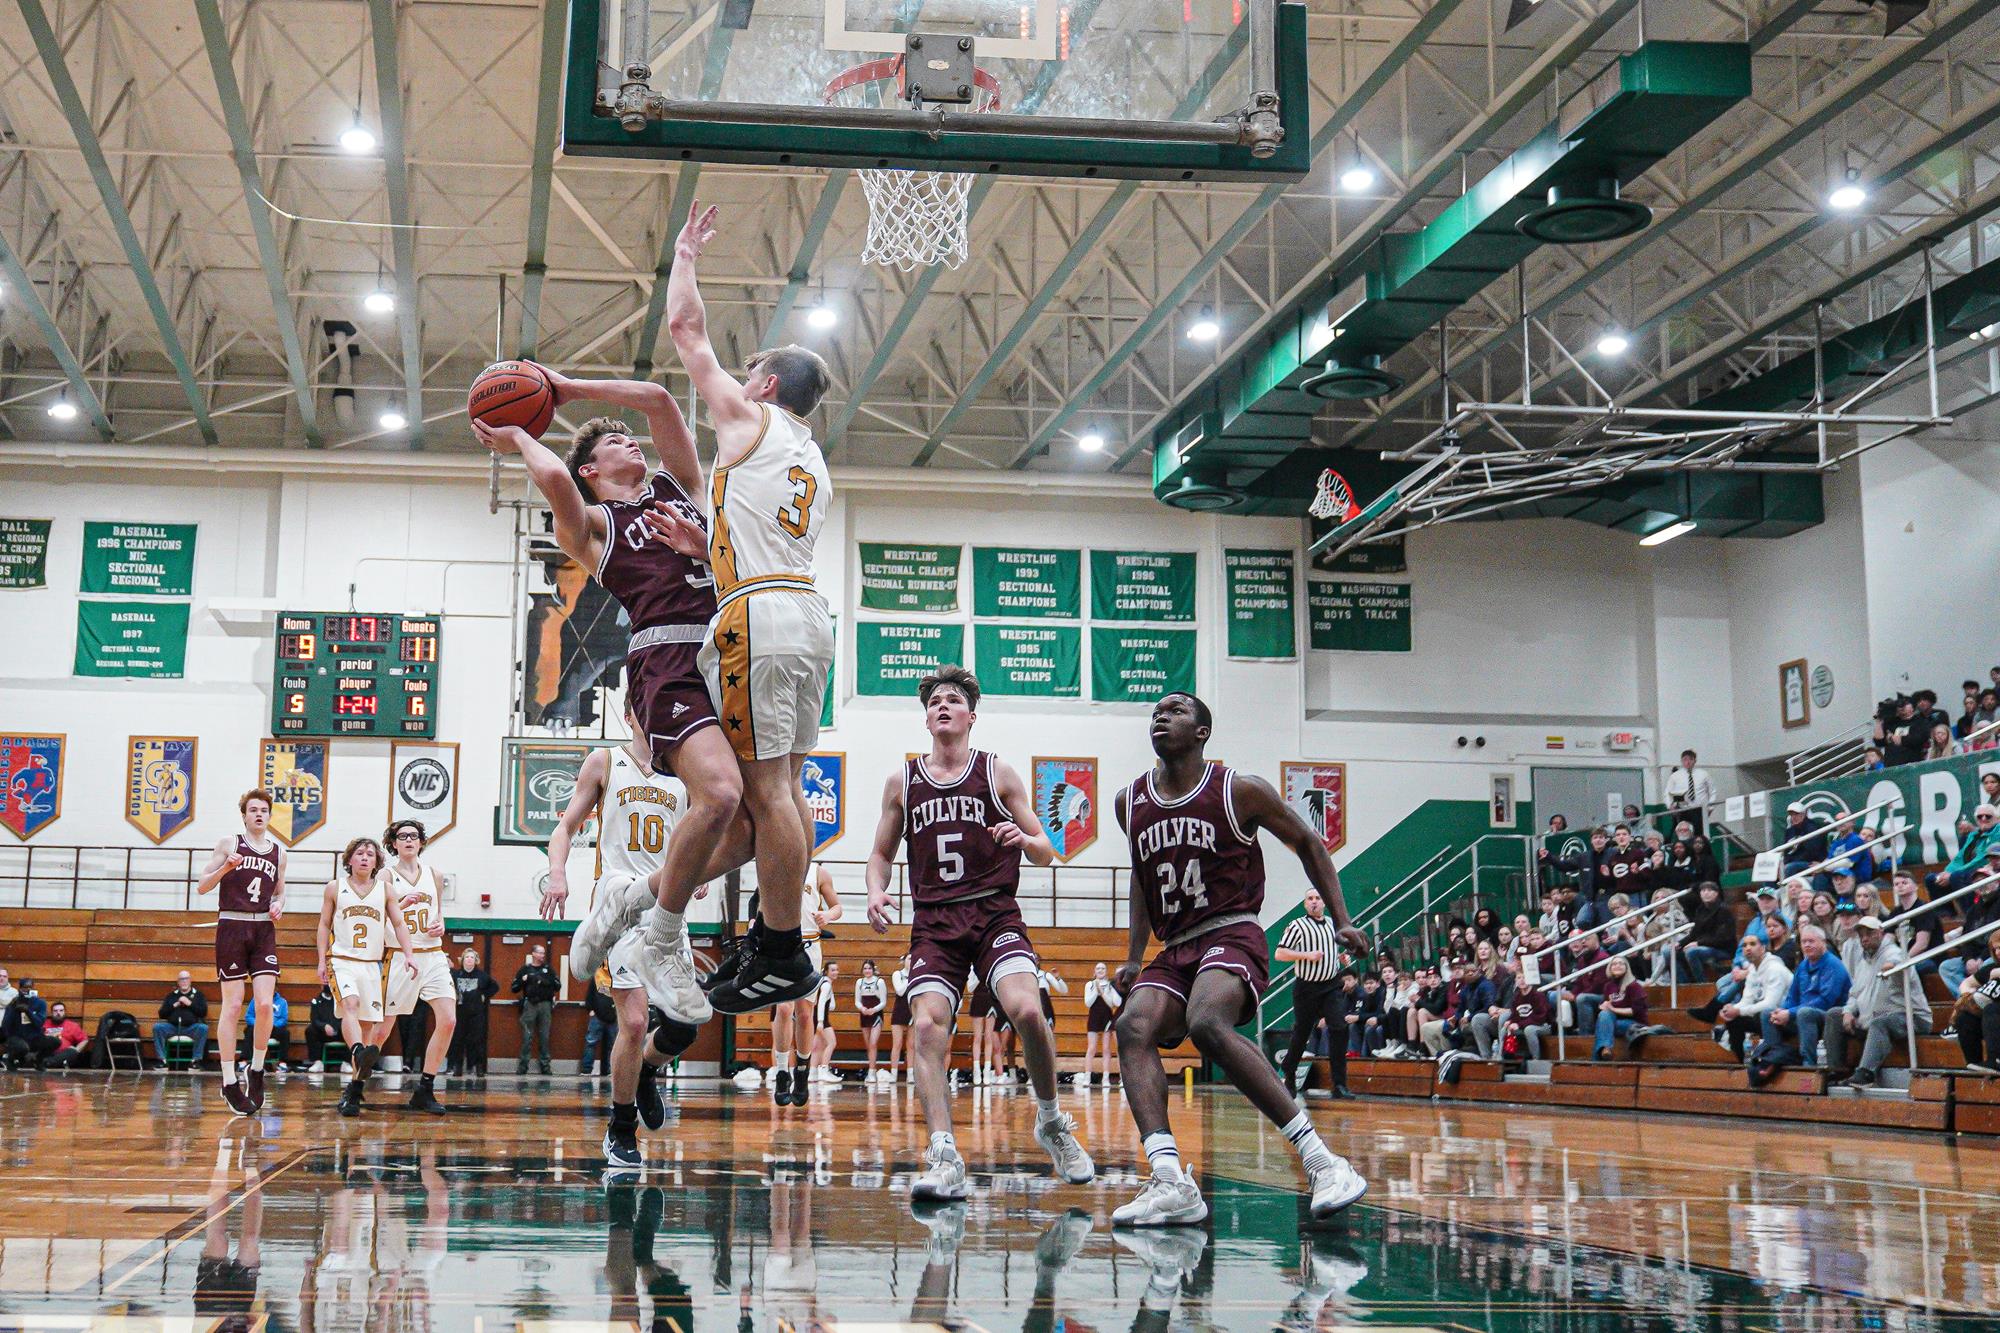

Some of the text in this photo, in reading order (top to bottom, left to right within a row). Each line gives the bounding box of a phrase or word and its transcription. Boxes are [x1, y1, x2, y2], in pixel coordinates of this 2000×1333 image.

[776, 464, 818, 540] 3
[112, 525, 167, 538] BASEBALL
[10, 544, 42, 554] CHAMPS
[97, 537, 183, 550] 1996 CHAMPIONS
[0, 554, 37, 564] NNER-UP
[128, 550, 148, 561] NIC
[883, 549, 938, 562] WRESTLING
[997, 552, 1057, 565] WRESTLING
[1115, 555, 1172, 568] WRESTLING
[108, 562, 166, 575] SECTIONAL
[864, 563, 956, 577] SECTIONAL CHAMPS
[1015, 567, 1041, 578] 1993
[1234, 569, 1288, 580] WRESTLING
[111, 574, 161, 586] REGIONAL
[998, 581, 1057, 594] SECTIONAL
[1115, 583, 1172, 596] SECTIONAL
[1234, 584, 1288, 595] SECTIONAL
[1341, 584, 1400, 596] WASHINGTON
[998, 595, 1058, 608] CHAMPIONS
[1115, 598, 1174, 610] CHAMPIONS
[1234, 598, 1289, 609] CHAMPIONS
[1310, 595, 1411, 608] REGIONAL CHAMPIONS
[111, 612, 156, 622] BASEBALL
[1364, 609, 1399, 620] TRACK
[283, 617, 311, 630] Home
[401, 620, 436, 633] Guests
[880, 626, 942, 639] WRESTLING
[999, 629, 1057, 641] WRESTLING
[298, 634, 316, 660] 9
[413, 636, 437, 662] 11
[899, 640, 923, 651] 1991
[1120, 638, 1170, 649] WRESTLING
[340, 659, 373, 671] period
[881, 654, 941, 666] SECTIONAL
[1000, 656, 1056, 668] SECTIONAL
[1010, 670, 1052, 682] CHAMPS
[1120, 669, 1168, 680] SECTIONAL
[283, 677, 307, 689] fouls
[339, 678, 372, 692] player
[404, 680, 428, 693] fouls
[1127, 683, 1164, 694] CHAMPS
[284, 719, 304, 729] won
[341, 719, 367, 732] game
[405, 722, 425, 732] won
[2, 737, 61, 748] ADAMS
[134, 741, 193, 752] CLAY
[131, 752, 143, 817] COLONIALS
[408, 772, 440, 791] NIC
[273, 786, 321, 804] RHS
[616, 785, 678, 813] TIGERS
[911, 795, 987, 834] CULVER
[627, 811, 665, 854] 10
[1137, 816, 1217, 863] CULVER
[936, 832, 965, 882] 5
[247, 876, 262, 904] 4
[1156, 858, 1209, 915] 24
[404, 908, 428, 935] 50
[352, 923, 368, 949] 2
